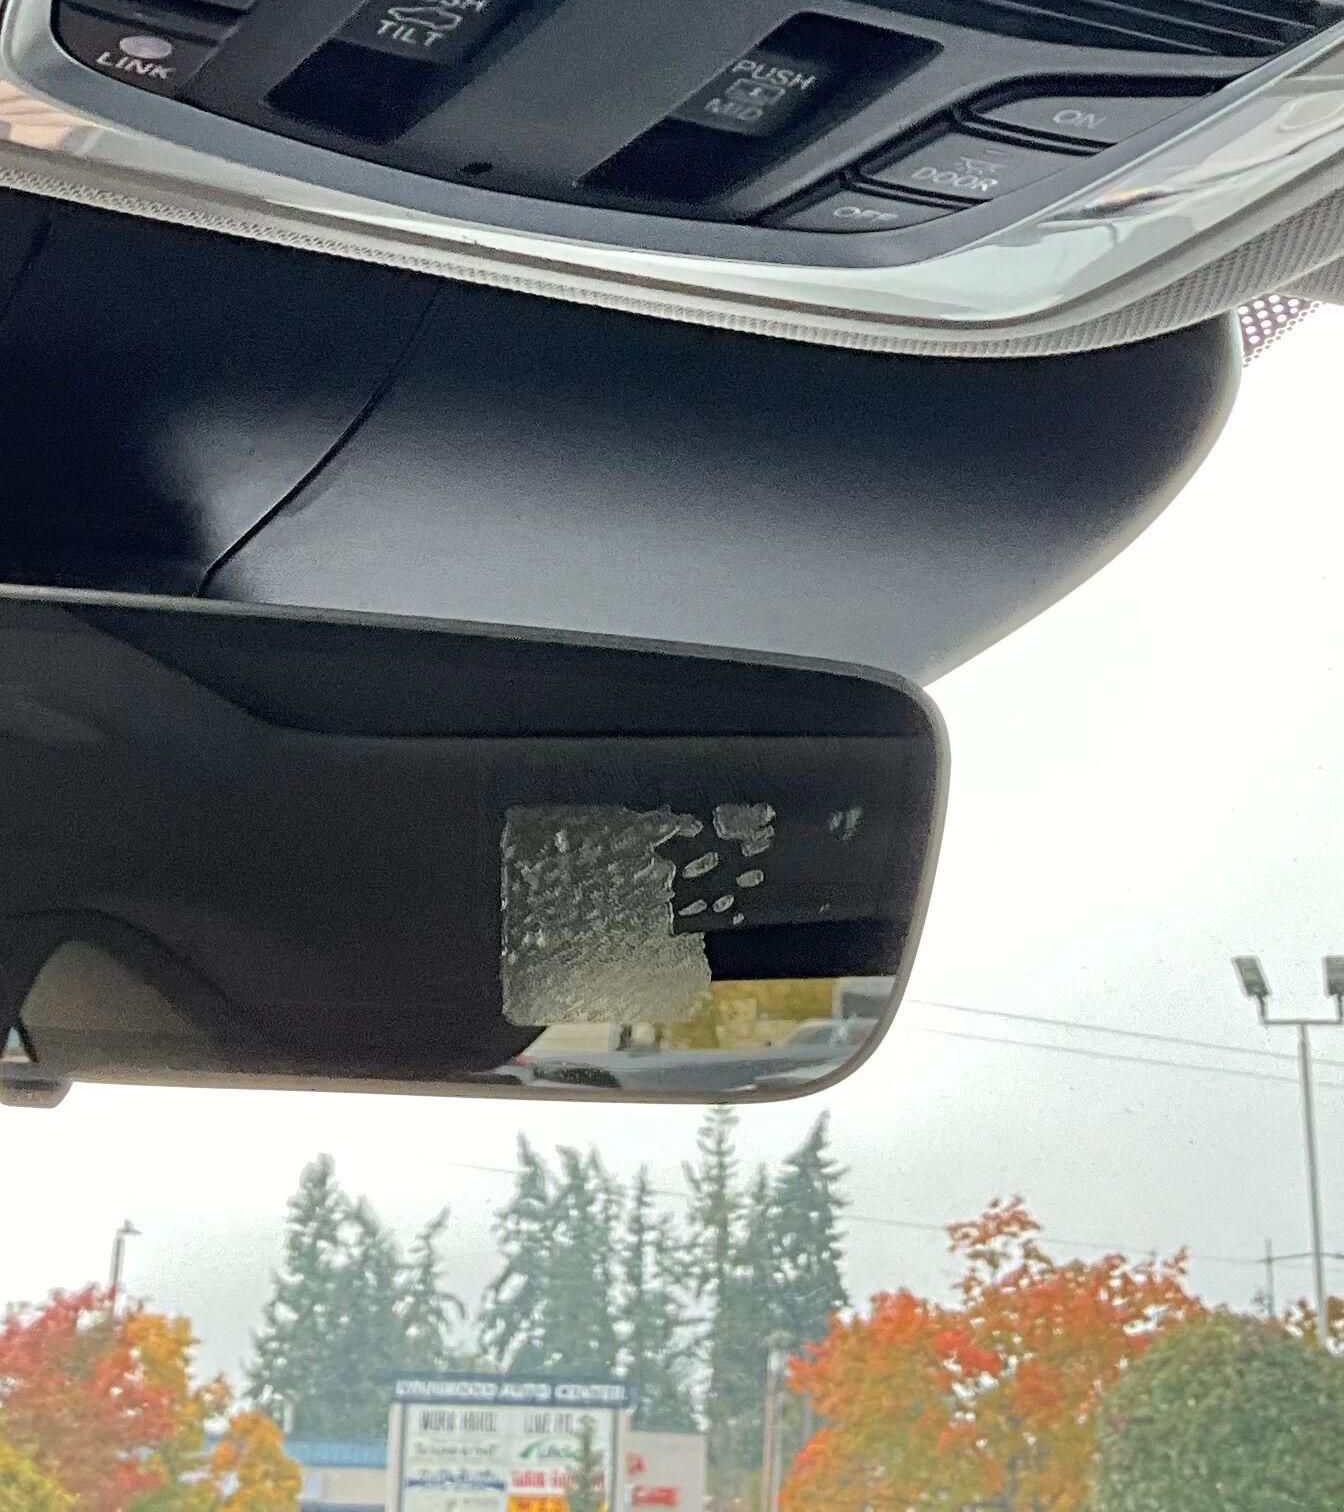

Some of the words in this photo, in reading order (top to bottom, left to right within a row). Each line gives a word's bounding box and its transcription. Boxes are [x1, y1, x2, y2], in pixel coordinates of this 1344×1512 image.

[376, 19, 444, 47] TILT
[96, 50, 176, 80] LINK
[731, 59, 816, 90] PUSH
[1053, 108, 1106, 129] ON
[911, 166, 999, 192] DOOR
[833, 205, 899, 222] OFF
